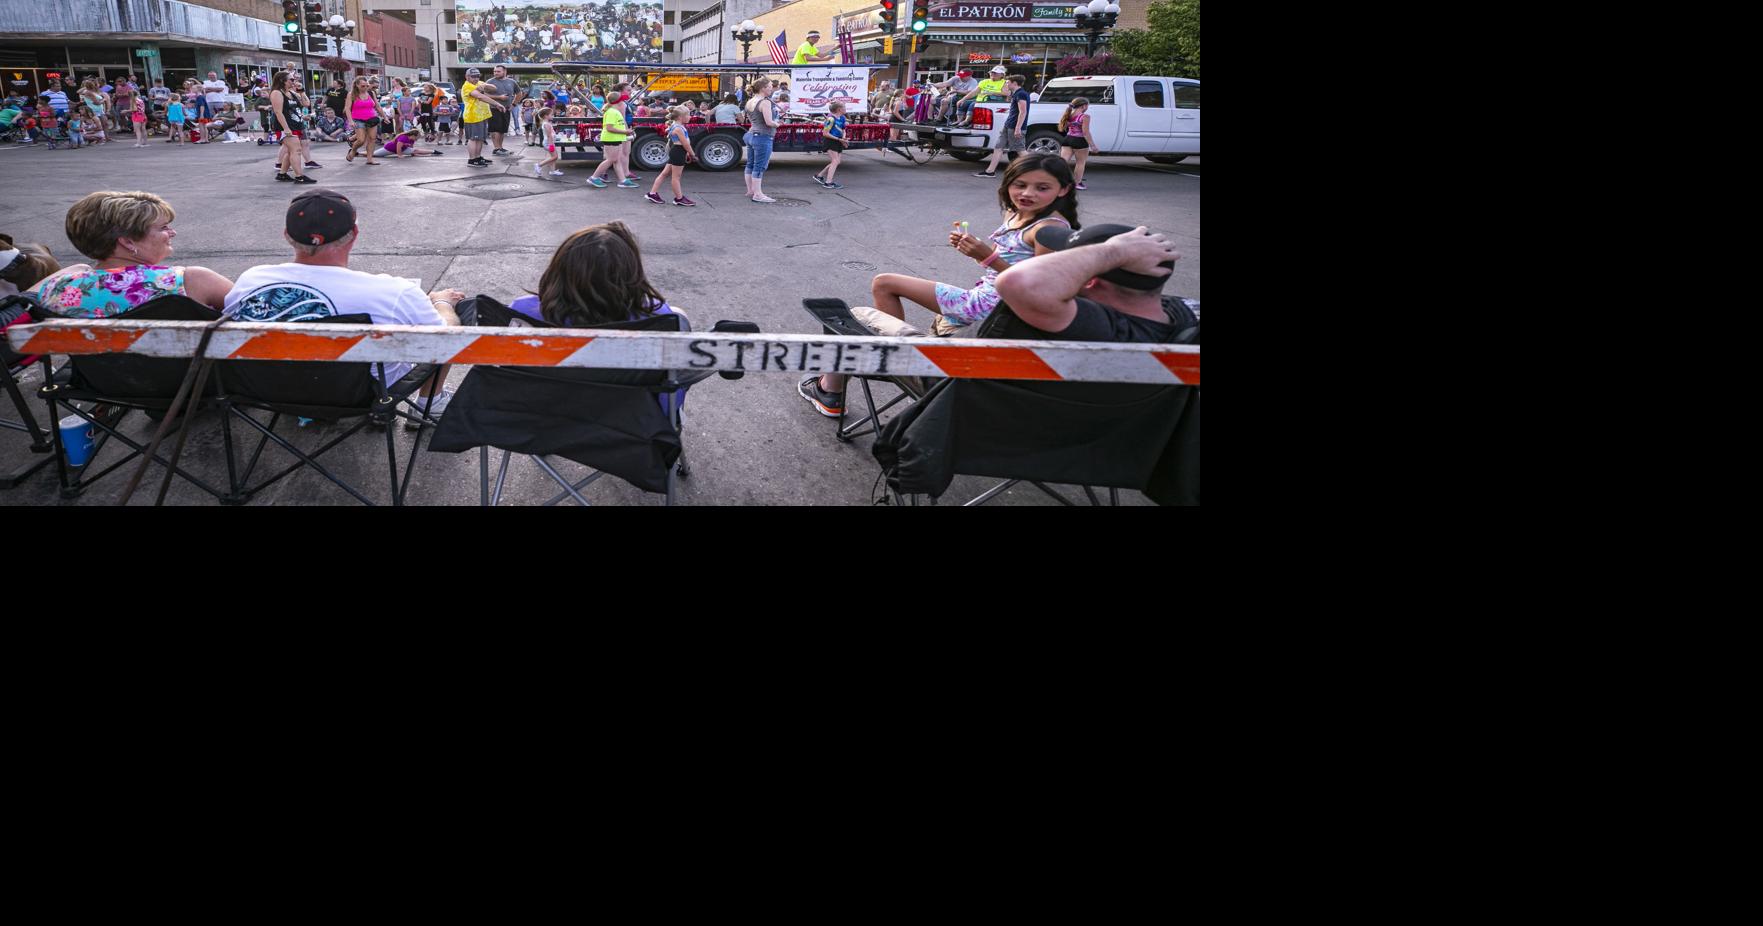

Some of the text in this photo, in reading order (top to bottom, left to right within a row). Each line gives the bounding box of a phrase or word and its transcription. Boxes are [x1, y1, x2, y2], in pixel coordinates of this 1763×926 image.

[939, 4, 1026, 18] EL PATRÓN
[1034, 7, 1063, 17] Family
[803, 82, 857, 92] Celebrating
[688, 339, 900, 373] STREET
